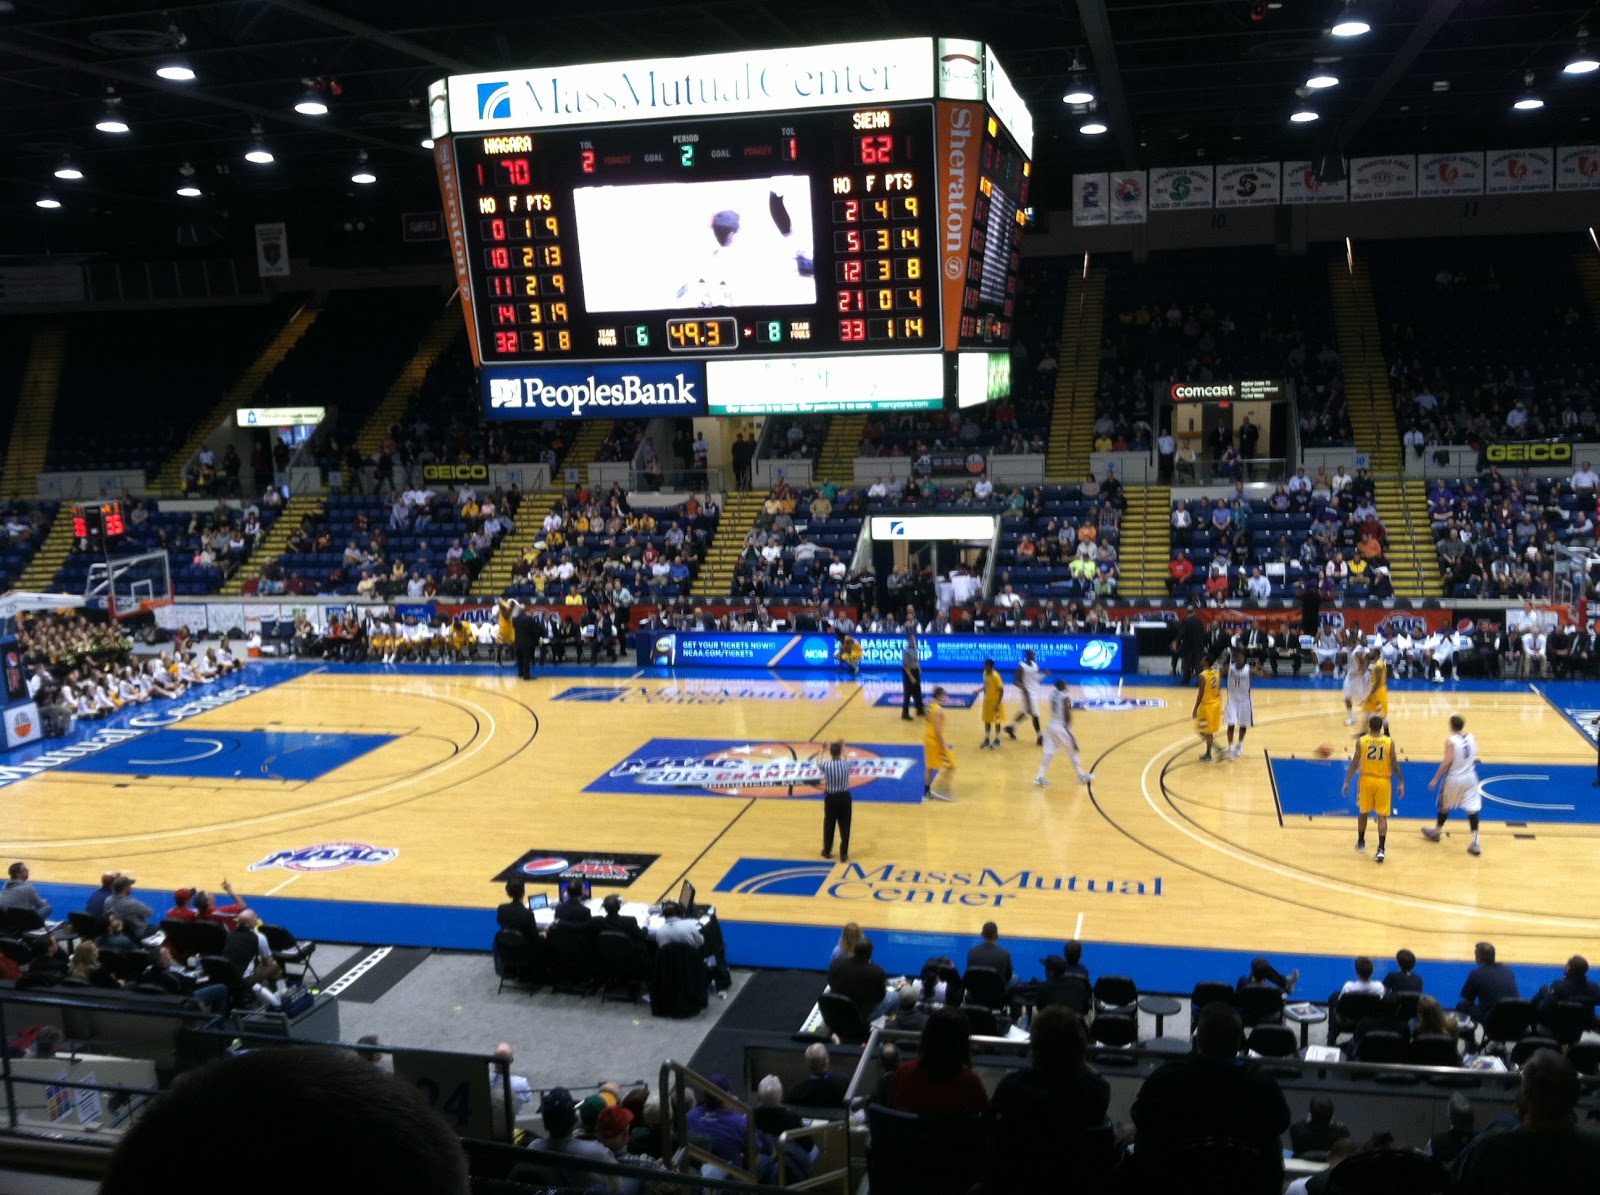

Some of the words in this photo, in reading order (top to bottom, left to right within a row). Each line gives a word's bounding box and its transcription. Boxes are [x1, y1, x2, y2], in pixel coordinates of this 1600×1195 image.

[526, 62, 750, 115] MassMutual
[760, 64, 897, 98] Center
[672, 134, 699, 143] PERIOD
[781, 127, 795, 136] TOL
[484, 135, 532, 154] NIAGARA
[580, 141, 593, 150] TOL
[711, 149, 730, 158] GOAL
[789, 137, 798, 160] 1
[862, 136, 892, 163] 62
[581, 150, 595, 173] 2
[644, 153, 663, 162] GOAL
[681, 144, 693, 167] 2
[501, 160, 530, 184] 70
[946, 107, 972, 252] Sheraton
[833, 177, 851, 194] NO
[866, 175, 875, 192] F
[885, 173, 912, 190] PTS
[480, 197, 496, 213] NO
[509, 196, 517, 212] F
[527, 194, 551, 211] PTS
[1083, 181, 1099, 208] 2
[845, 200, 859, 222] 2
[875, 199, 888, 219] 4
[904, 197, 918, 218] 9
[492, 218, 505, 240] 0
[525, 219, 532, 238] 1
[546, 217, 558, 237] 9
[847, 230, 860, 252] 5
[877, 229, 890, 250] 3
[901, 228, 920, 249] 14
[492, 247, 509, 269] 10
[522, 247, 534, 268] 2
[545, 246, 562, 266] 13
[844, 260, 861, 282] 12
[878, 259, 891, 279] 3
[907, 258, 921, 279] 8
[494, 276, 512, 296] 11
[525, 276, 537, 296] 2
[552, 274, 565, 294] 9
[838, 290, 864, 312] 21
[879, 289, 893, 310] 0
[908, 288, 922, 309] 4
[498, 304, 516, 324] 14
[530, 304, 541, 324] 3
[551, 302, 568, 322] 19
[598, 329, 616, 338] TEAM
[637, 326, 649, 346] 6
[670, 322, 720, 347] 49.3
[768, 321, 781, 342] 8
[790, 331, 811, 340] FOULS
[791, 322, 809, 331] TEAM
[839, 319, 865, 341] 33
[887, 319, 894, 339] 1
[904, 318, 923, 338] 14
[496, 332, 518, 352] 32
[533, 331, 545, 352] 3
[558, 330, 571, 350] 8
[598, 337, 617, 346] FOULS
[523, 373, 697, 416] PeoplesBank
[1175, 384, 1235, 399] comcast
[878, 400, 928, 409] mercycares.com
[1486, 443, 1571, 461] GEICO
[423, 465, 487, 480] GEICO
[805, 650, 828, 659] NCAA
[861, 639, 931, 649] BASKETBLL
[1367, 745, 1384, 760] 21
[646, 771, 709, 782] 2013
[716, 768, 896, 781] CHAMPIOHIPS
[840, 862, 1164, 896] MassMutual
[827, 882, 1017, 907] Center
